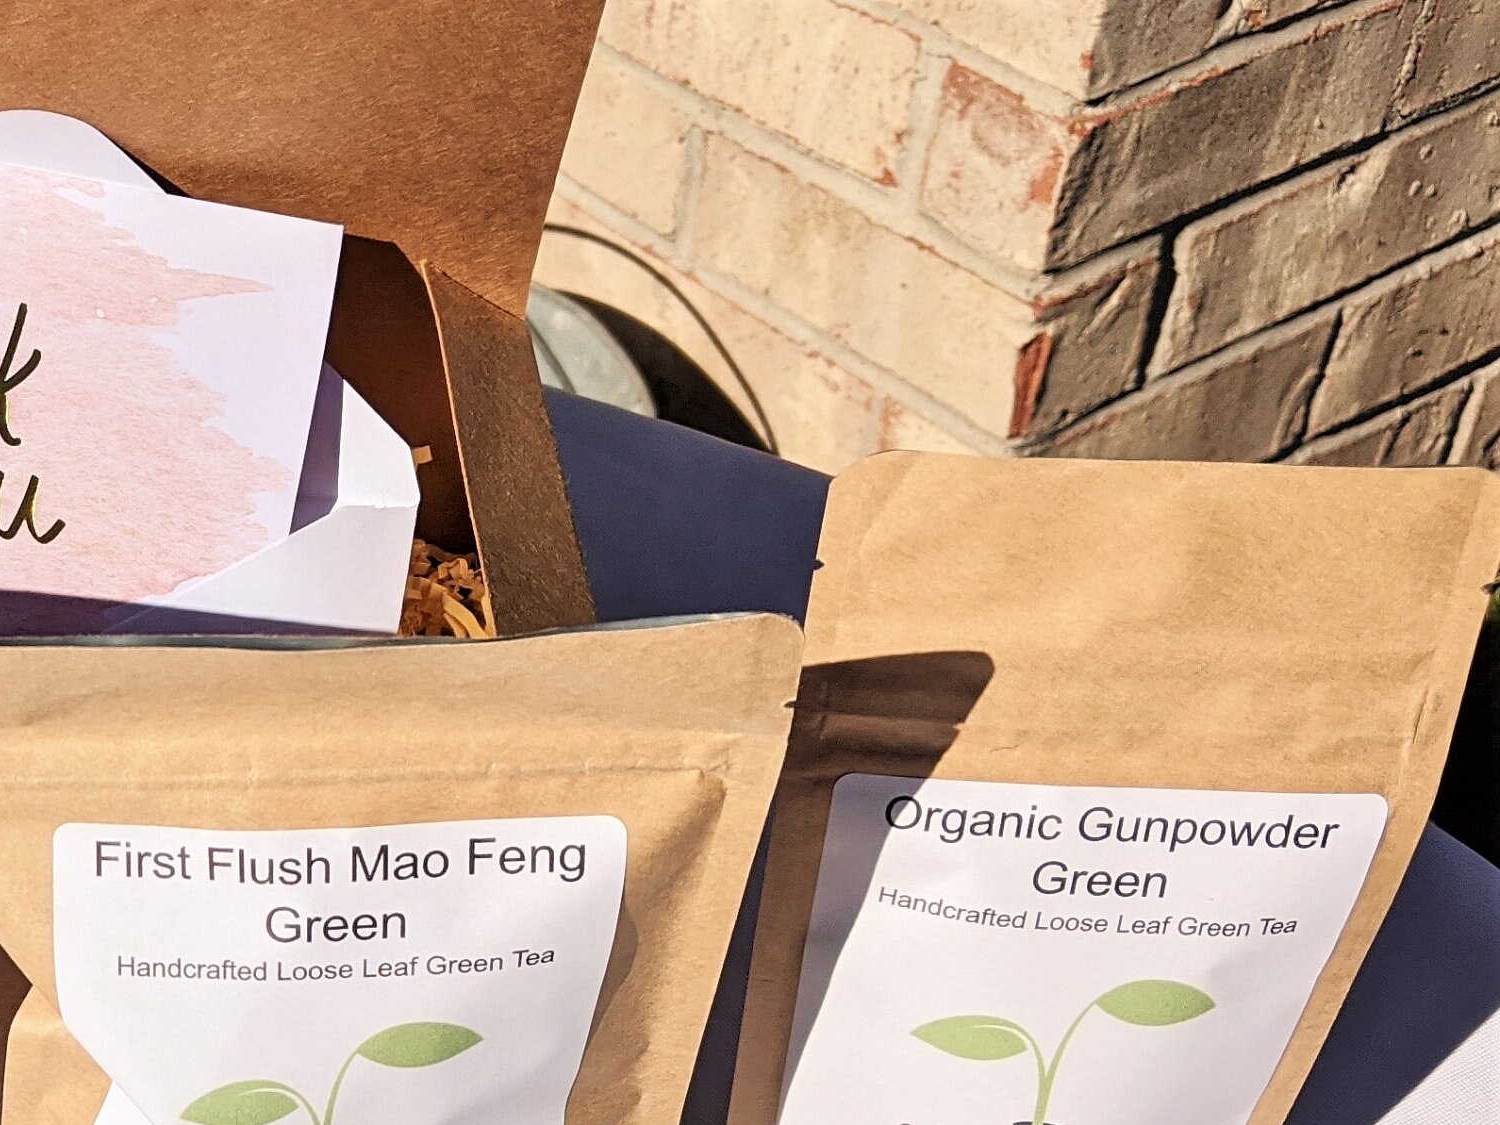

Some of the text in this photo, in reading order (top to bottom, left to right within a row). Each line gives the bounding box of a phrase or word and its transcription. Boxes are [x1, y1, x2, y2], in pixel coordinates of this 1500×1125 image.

[885, 796, 1340, 852] Organic Gunpowder
[96, 838, 585, 885] First Flush Mao Feng
[1033, 861, 1167, 898] Green
[266, 907, 405, 943] Green
[879, 887, 1298, 937] Handcrafted Loose Leaf Green Tea
[118, 949, 555, 982] Handcrafted Loose Leaf Green Tea
